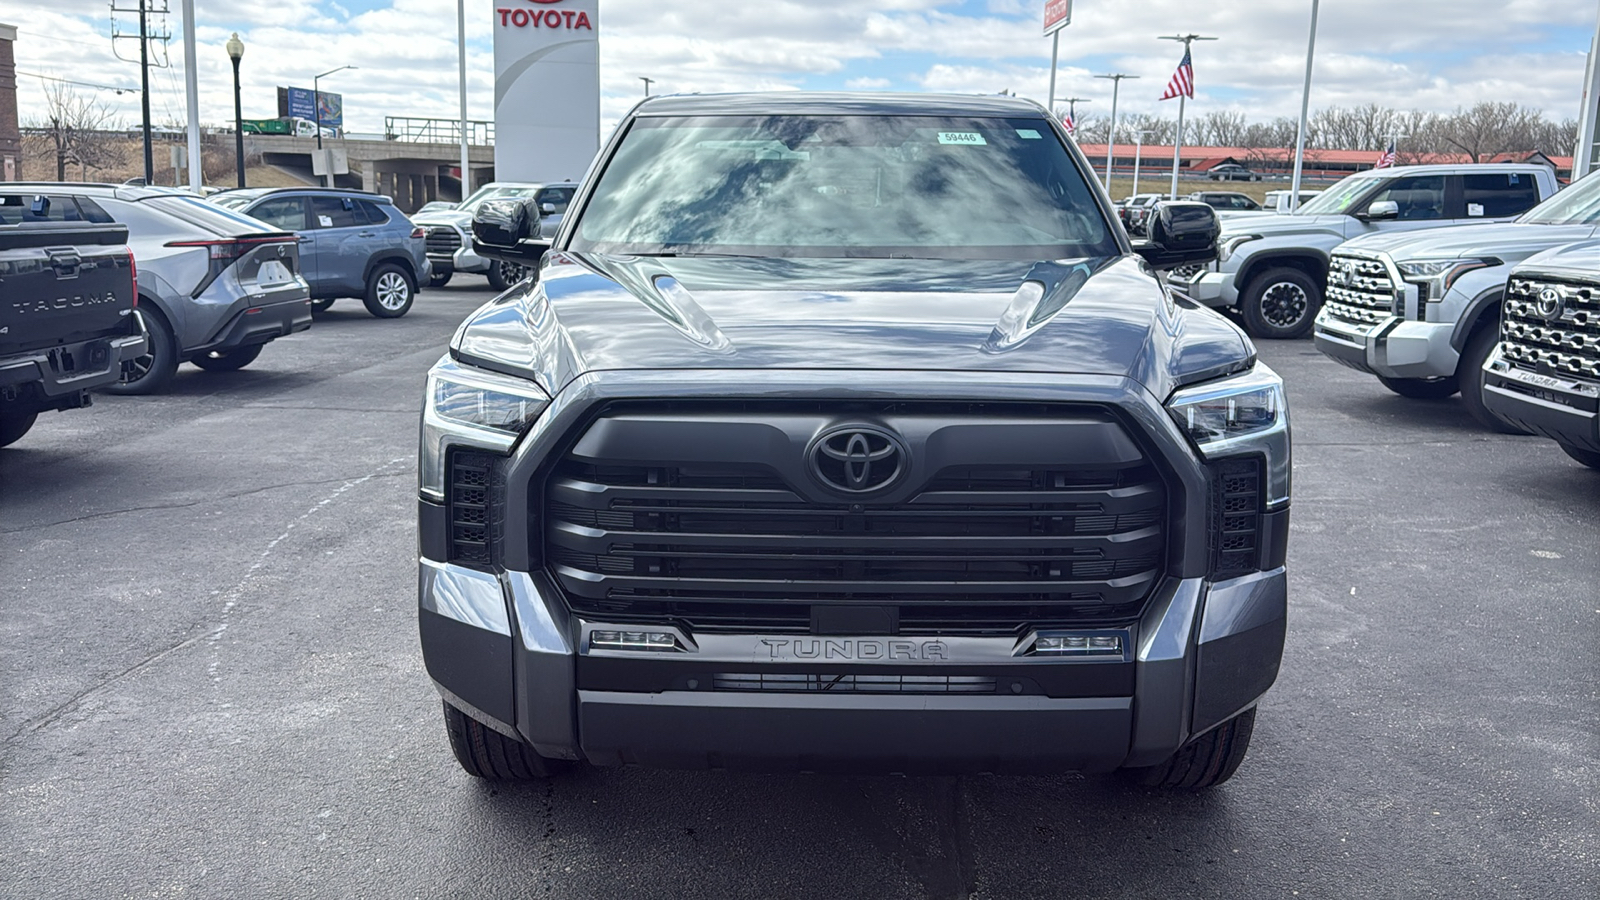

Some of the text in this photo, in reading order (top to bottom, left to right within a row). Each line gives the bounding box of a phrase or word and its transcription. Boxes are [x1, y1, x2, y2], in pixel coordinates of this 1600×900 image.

[497, 8, 592, 30] TOYOTA
[945, 133, 977, 142] 59446
[13, 291, 116, 314] TACOMA
[1517, 371, 1559, 388] TUNDRA
[760, 639, 949, 660] TUNDRA
